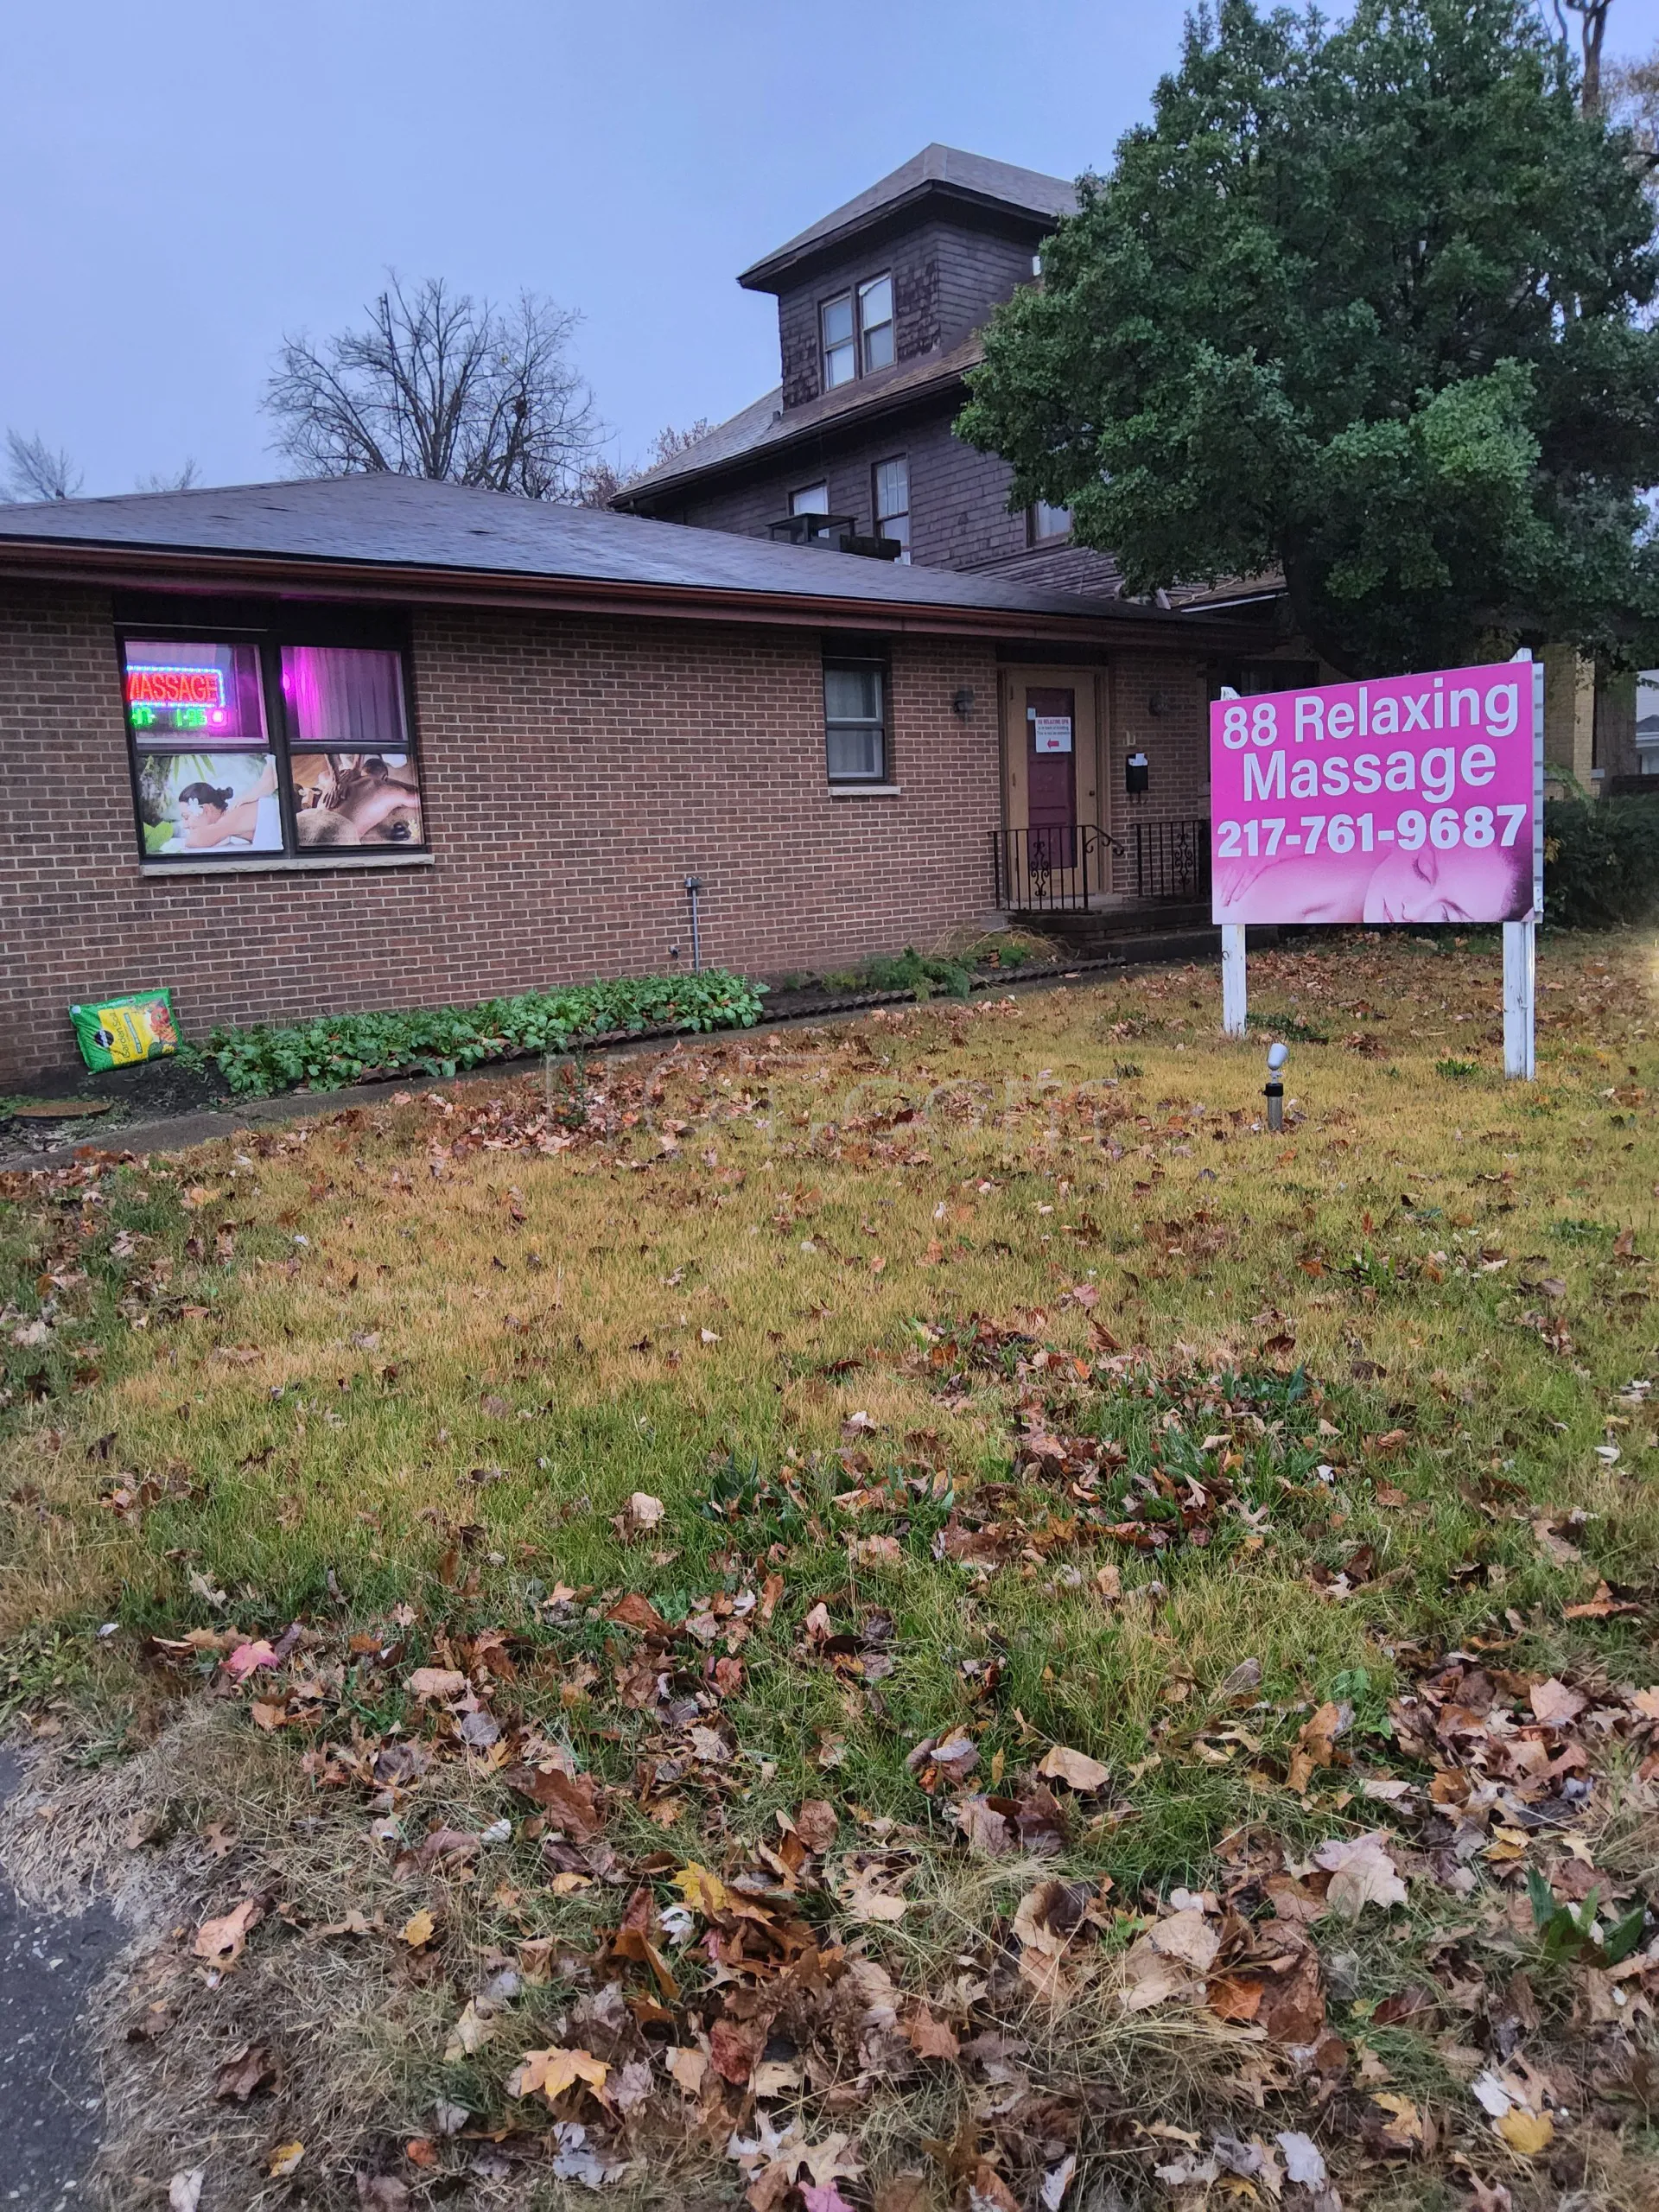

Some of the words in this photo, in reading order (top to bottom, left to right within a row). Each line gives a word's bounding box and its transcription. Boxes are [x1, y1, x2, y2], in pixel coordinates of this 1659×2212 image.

[1223, 702, 1278, 750] 88
[1294, 677, 1518, 742] Relaxing
[1243, 742, 1497, 804] Massage
[1217, 804, 1527, 858] 217-761-9687
